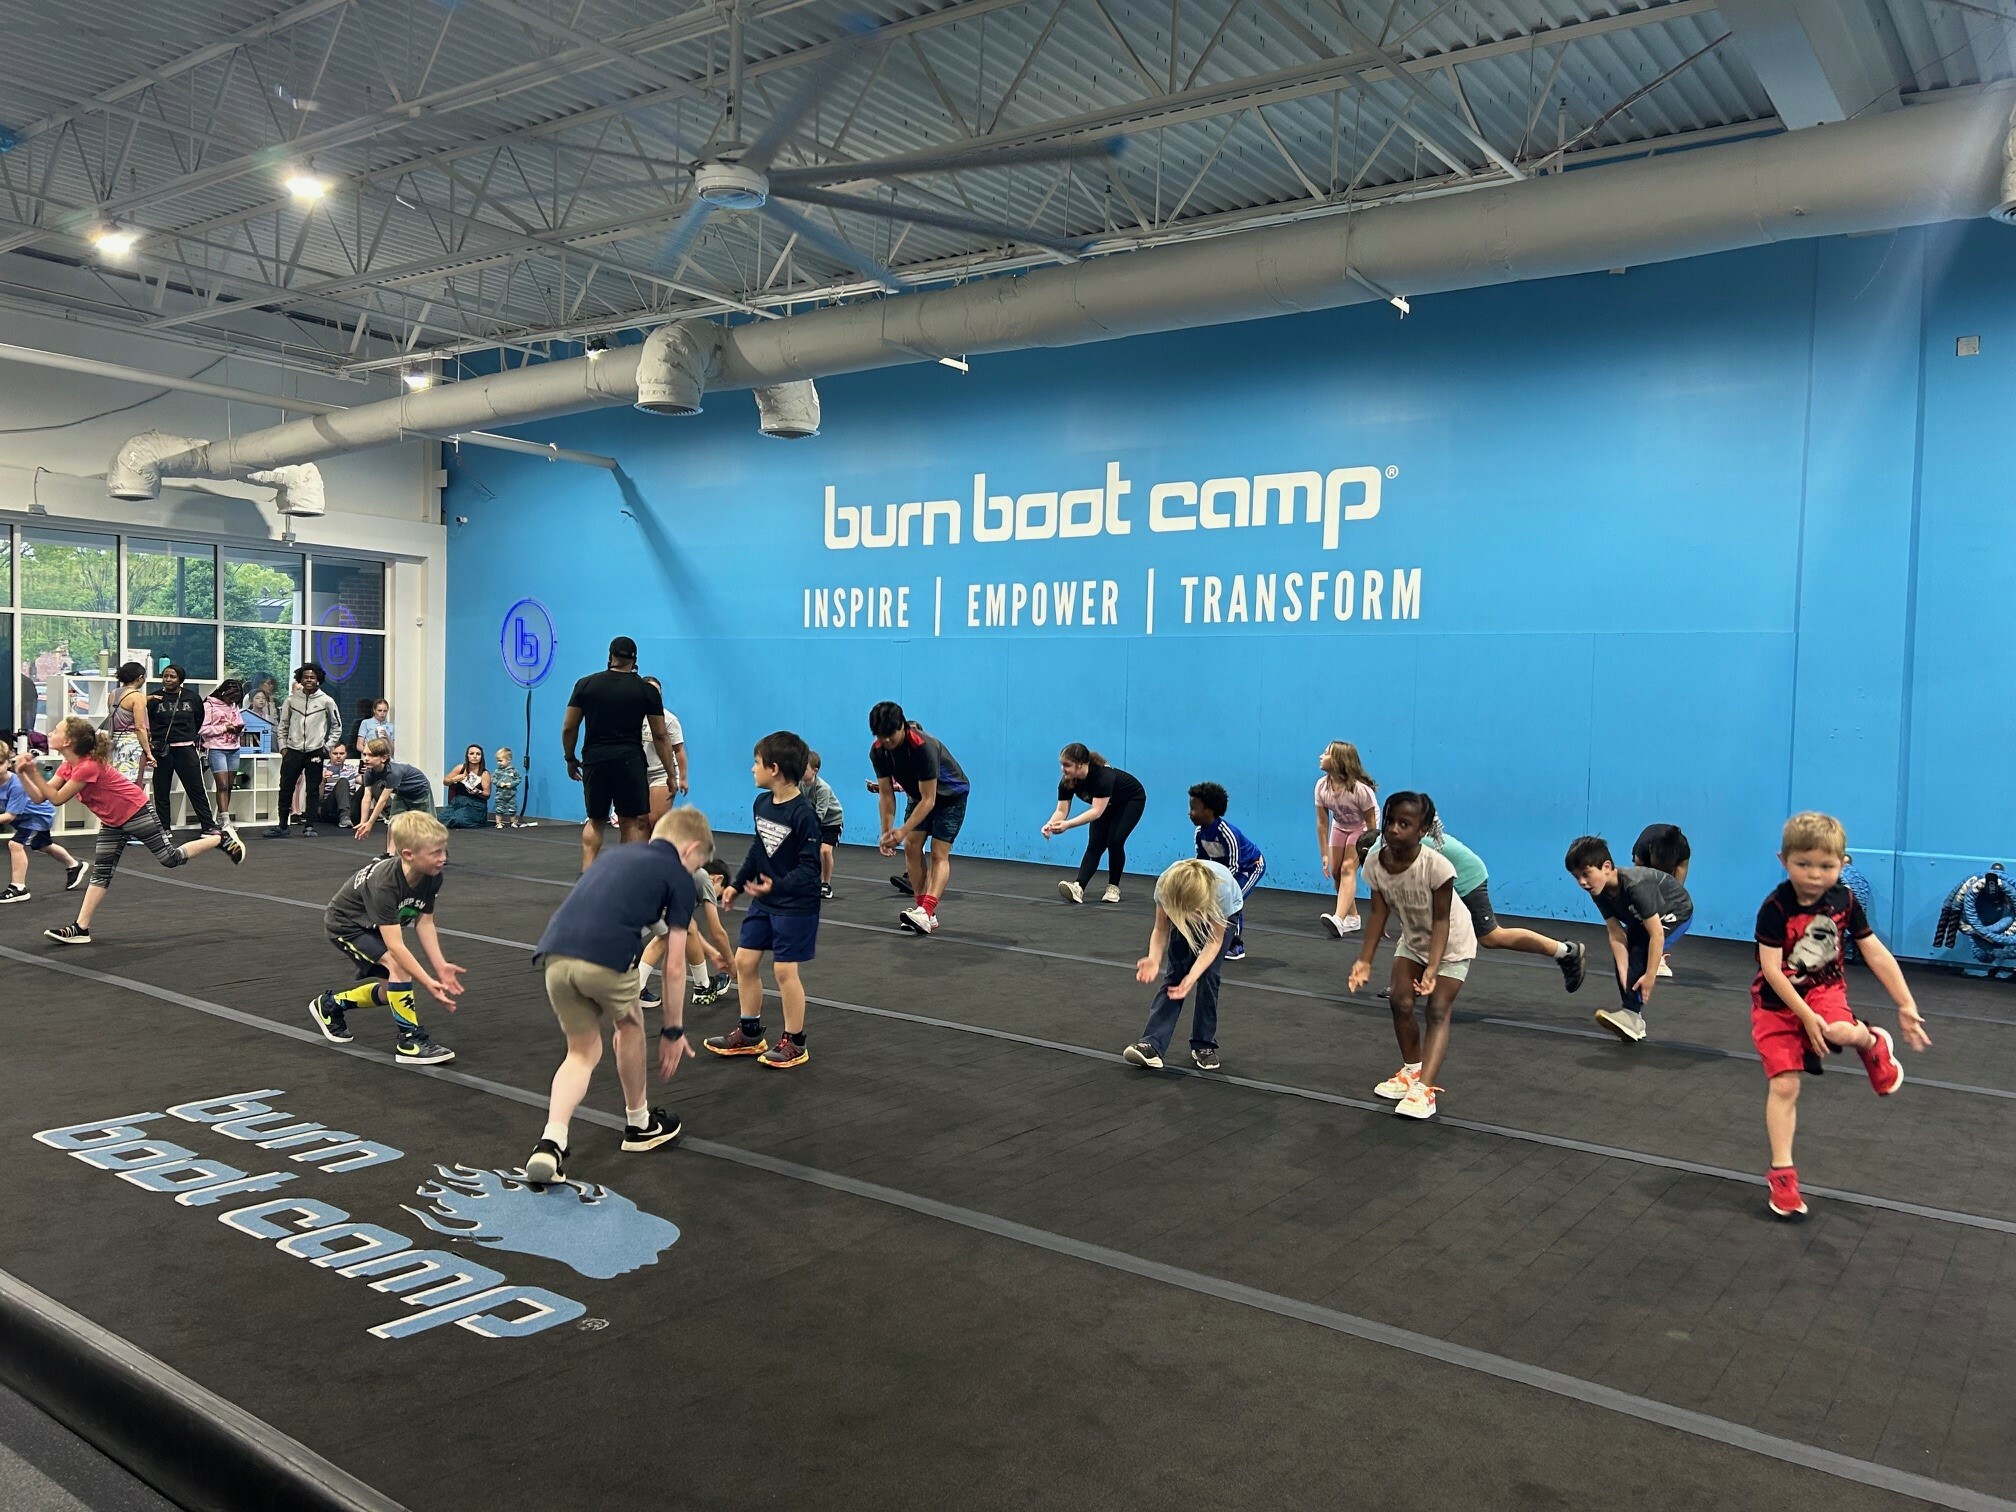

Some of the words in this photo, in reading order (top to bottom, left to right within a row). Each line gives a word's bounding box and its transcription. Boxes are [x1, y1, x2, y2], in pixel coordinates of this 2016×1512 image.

[824, 485, 962, 550] burn
[972, 461, 1132, 543] boot
[804, 586, 910, 628] INSPIRE
[967, 580, 1119, 627] EMPOWER
[1180, 568, 1422, 624] TRANSFORM
[515, 617, 539, 667] b
[31, 1112, 300, 1207] boot
[166, 1089, 405, 1174] burn
